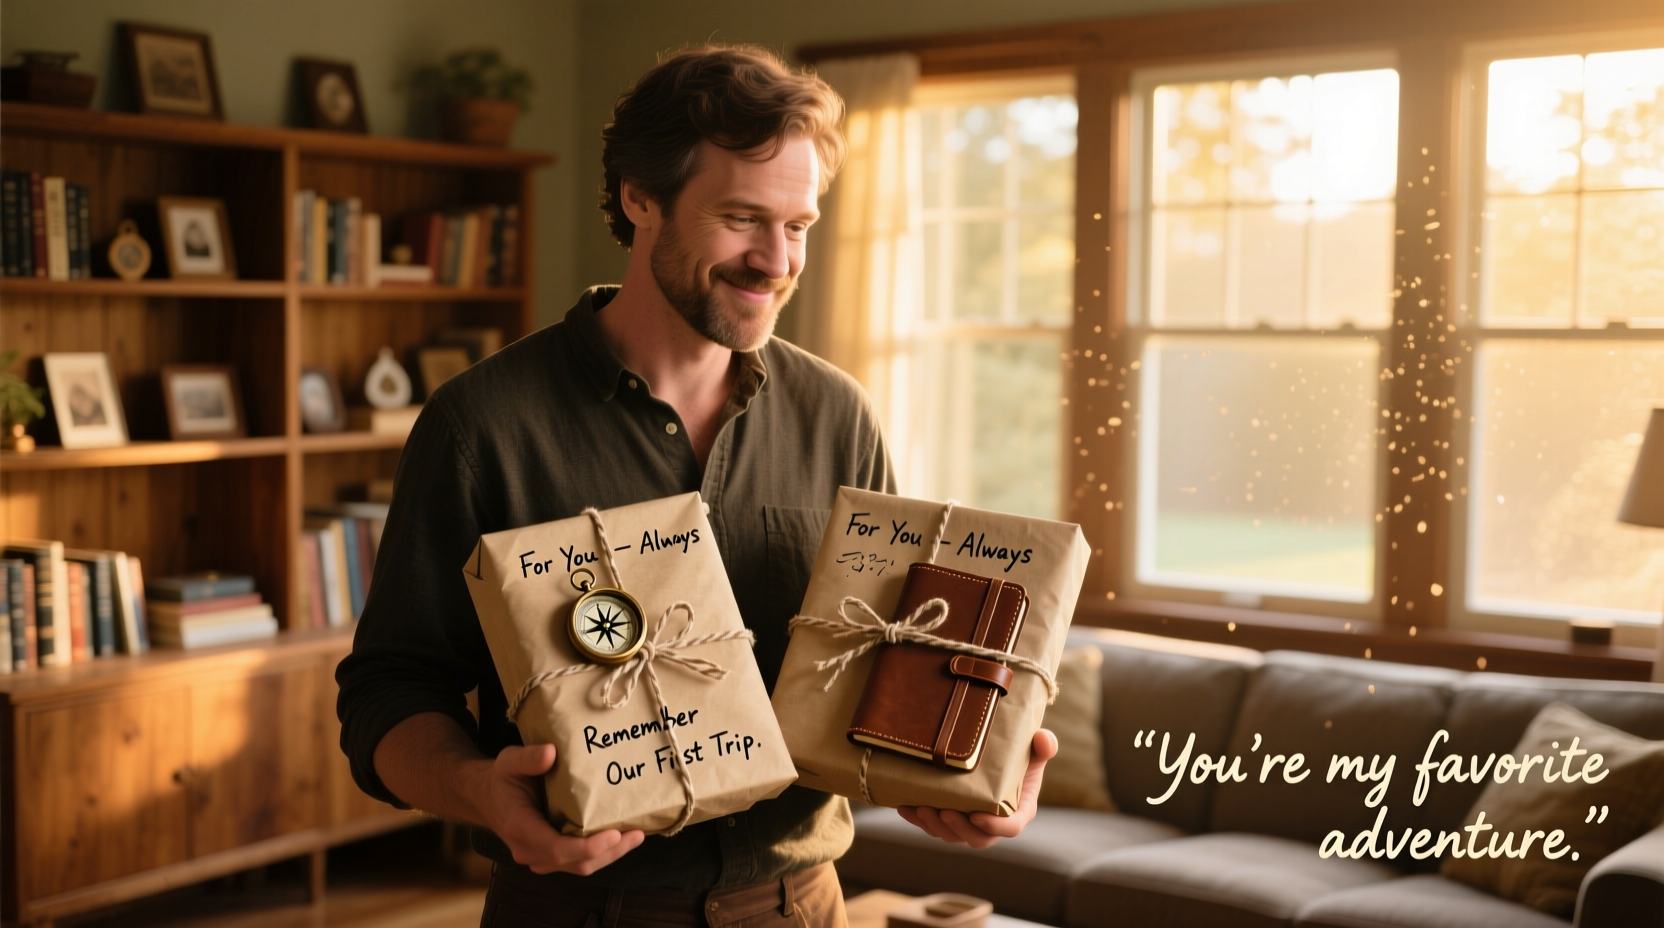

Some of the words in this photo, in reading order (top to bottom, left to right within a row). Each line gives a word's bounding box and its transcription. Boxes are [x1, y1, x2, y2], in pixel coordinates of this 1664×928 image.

[519, 550, 553, 578] For
[559, 545, 599, 573] You
[846, 512, 880, 537] For
[889, 519, 922, 547] You
[956, 531, 1033, 573] Always
[583, 705, 699, 754] Remember
[606, 761, 646, 785] Our
[709, 730, 761, 761] Trip.
